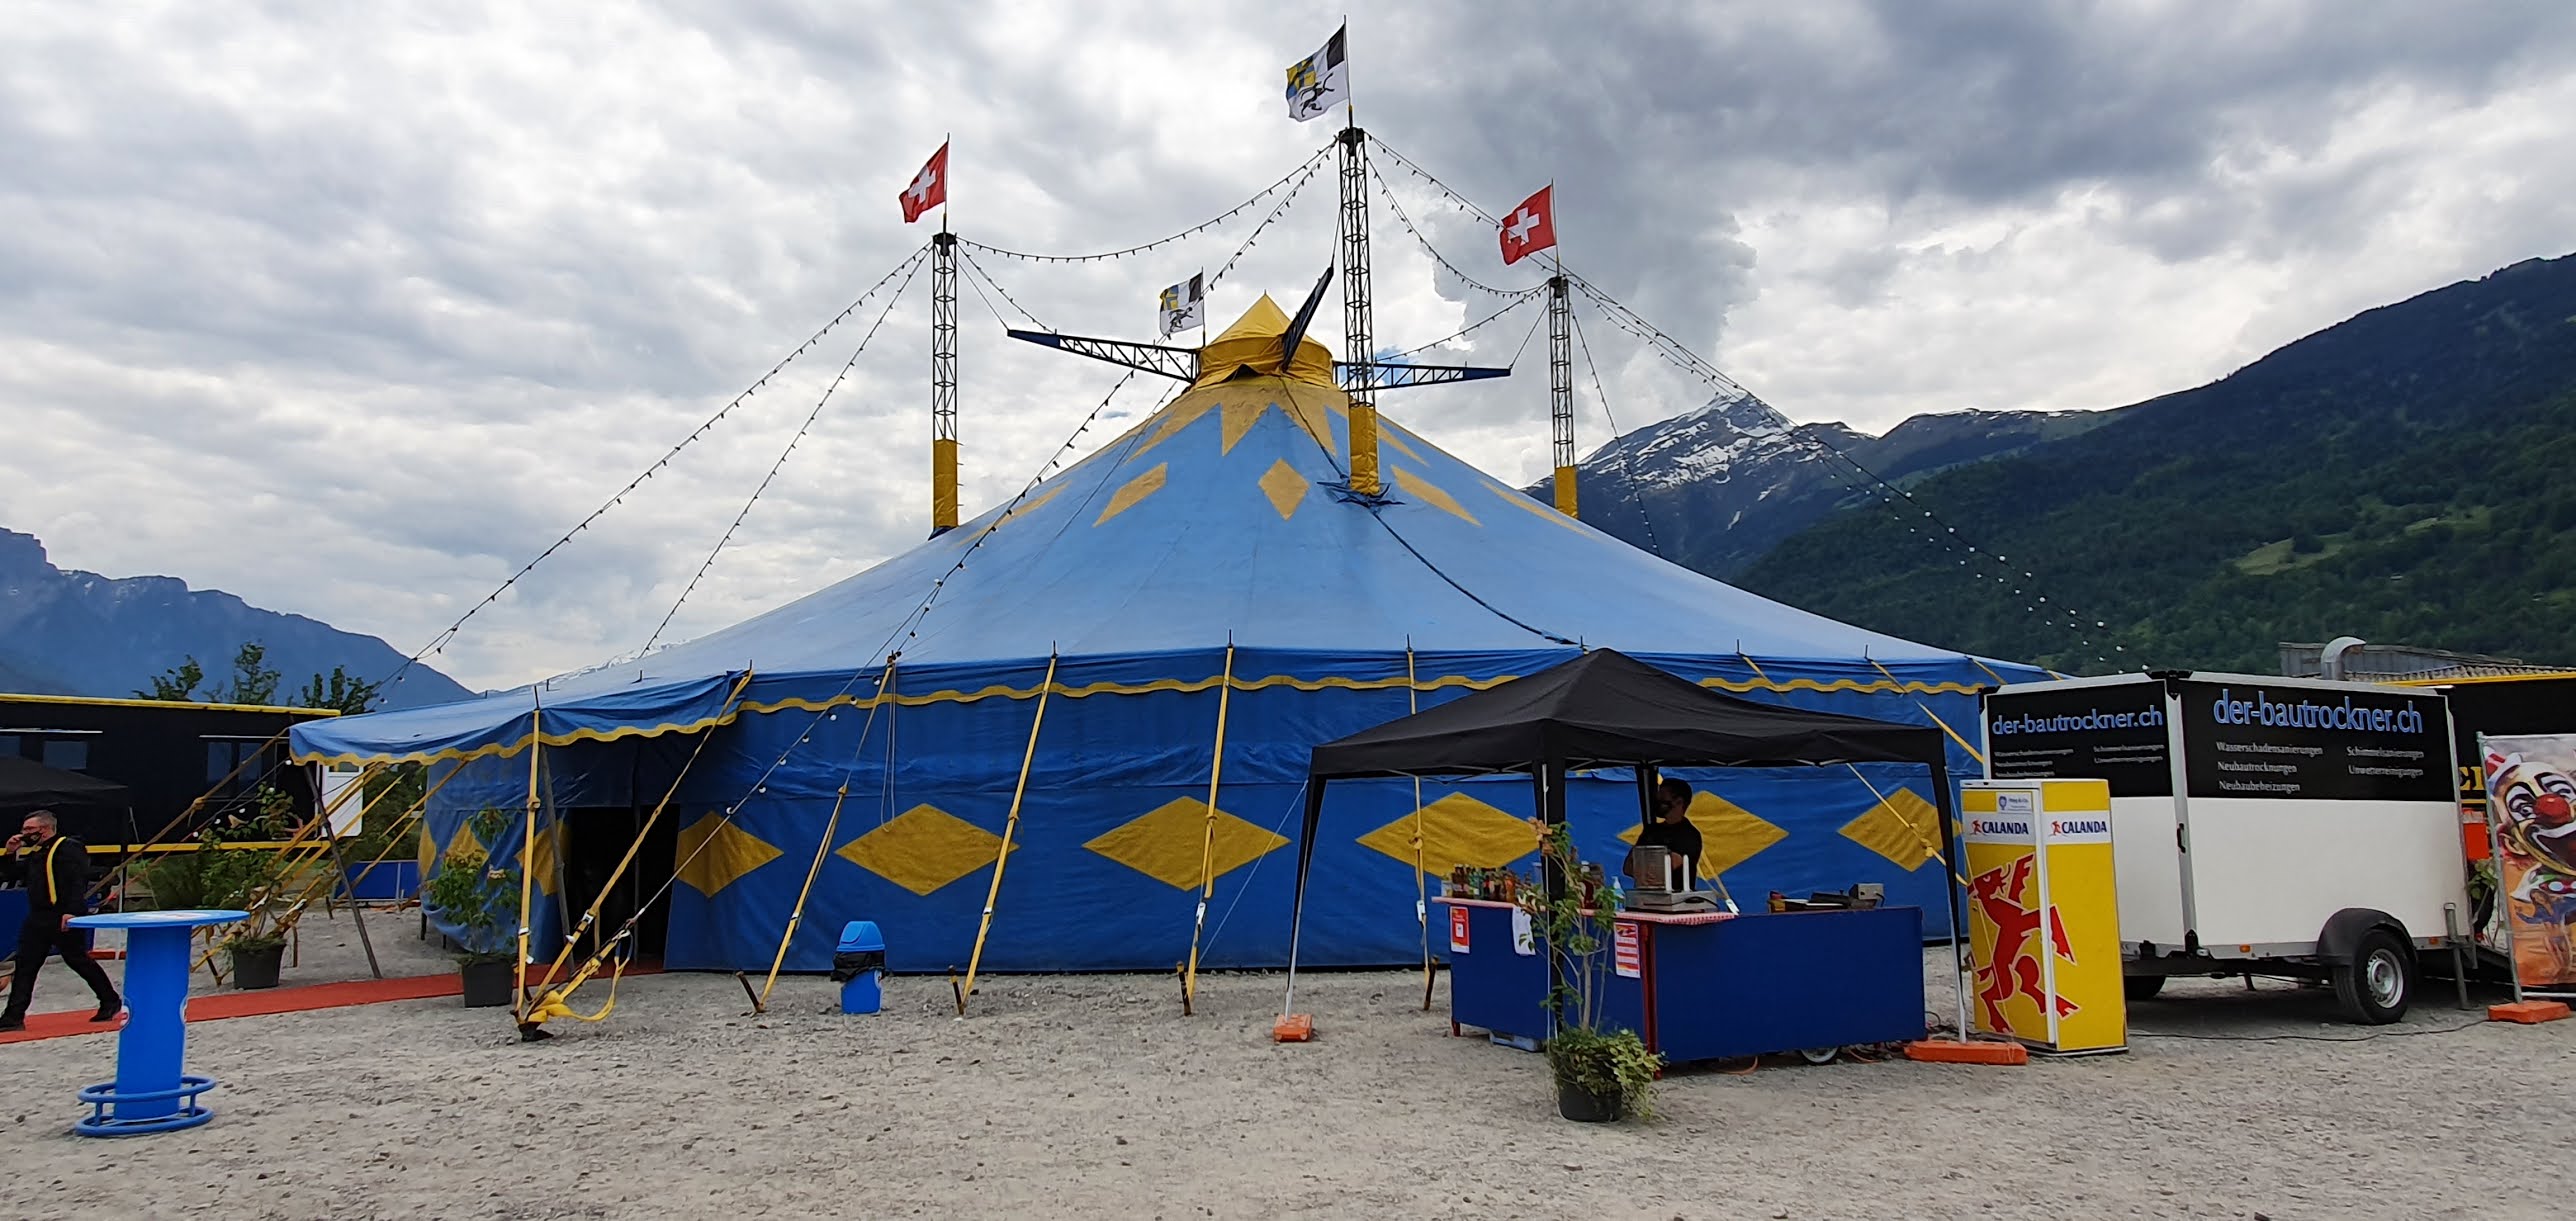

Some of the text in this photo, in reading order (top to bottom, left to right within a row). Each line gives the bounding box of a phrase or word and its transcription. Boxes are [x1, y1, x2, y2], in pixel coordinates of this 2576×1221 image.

[2213, 689, 2423, 733] der-bautrockner.ch
[1992, 705, 2163, 734] der-bautrockner.ch
[2216, 741, 2324, 757] Wasserschadensanierungen
[2217, 761, 2298, 775] Neubautrocknungen
[1982, 821, 2029, 835] CALANDA
[2061, 821, 2107, 834] CALANDA
